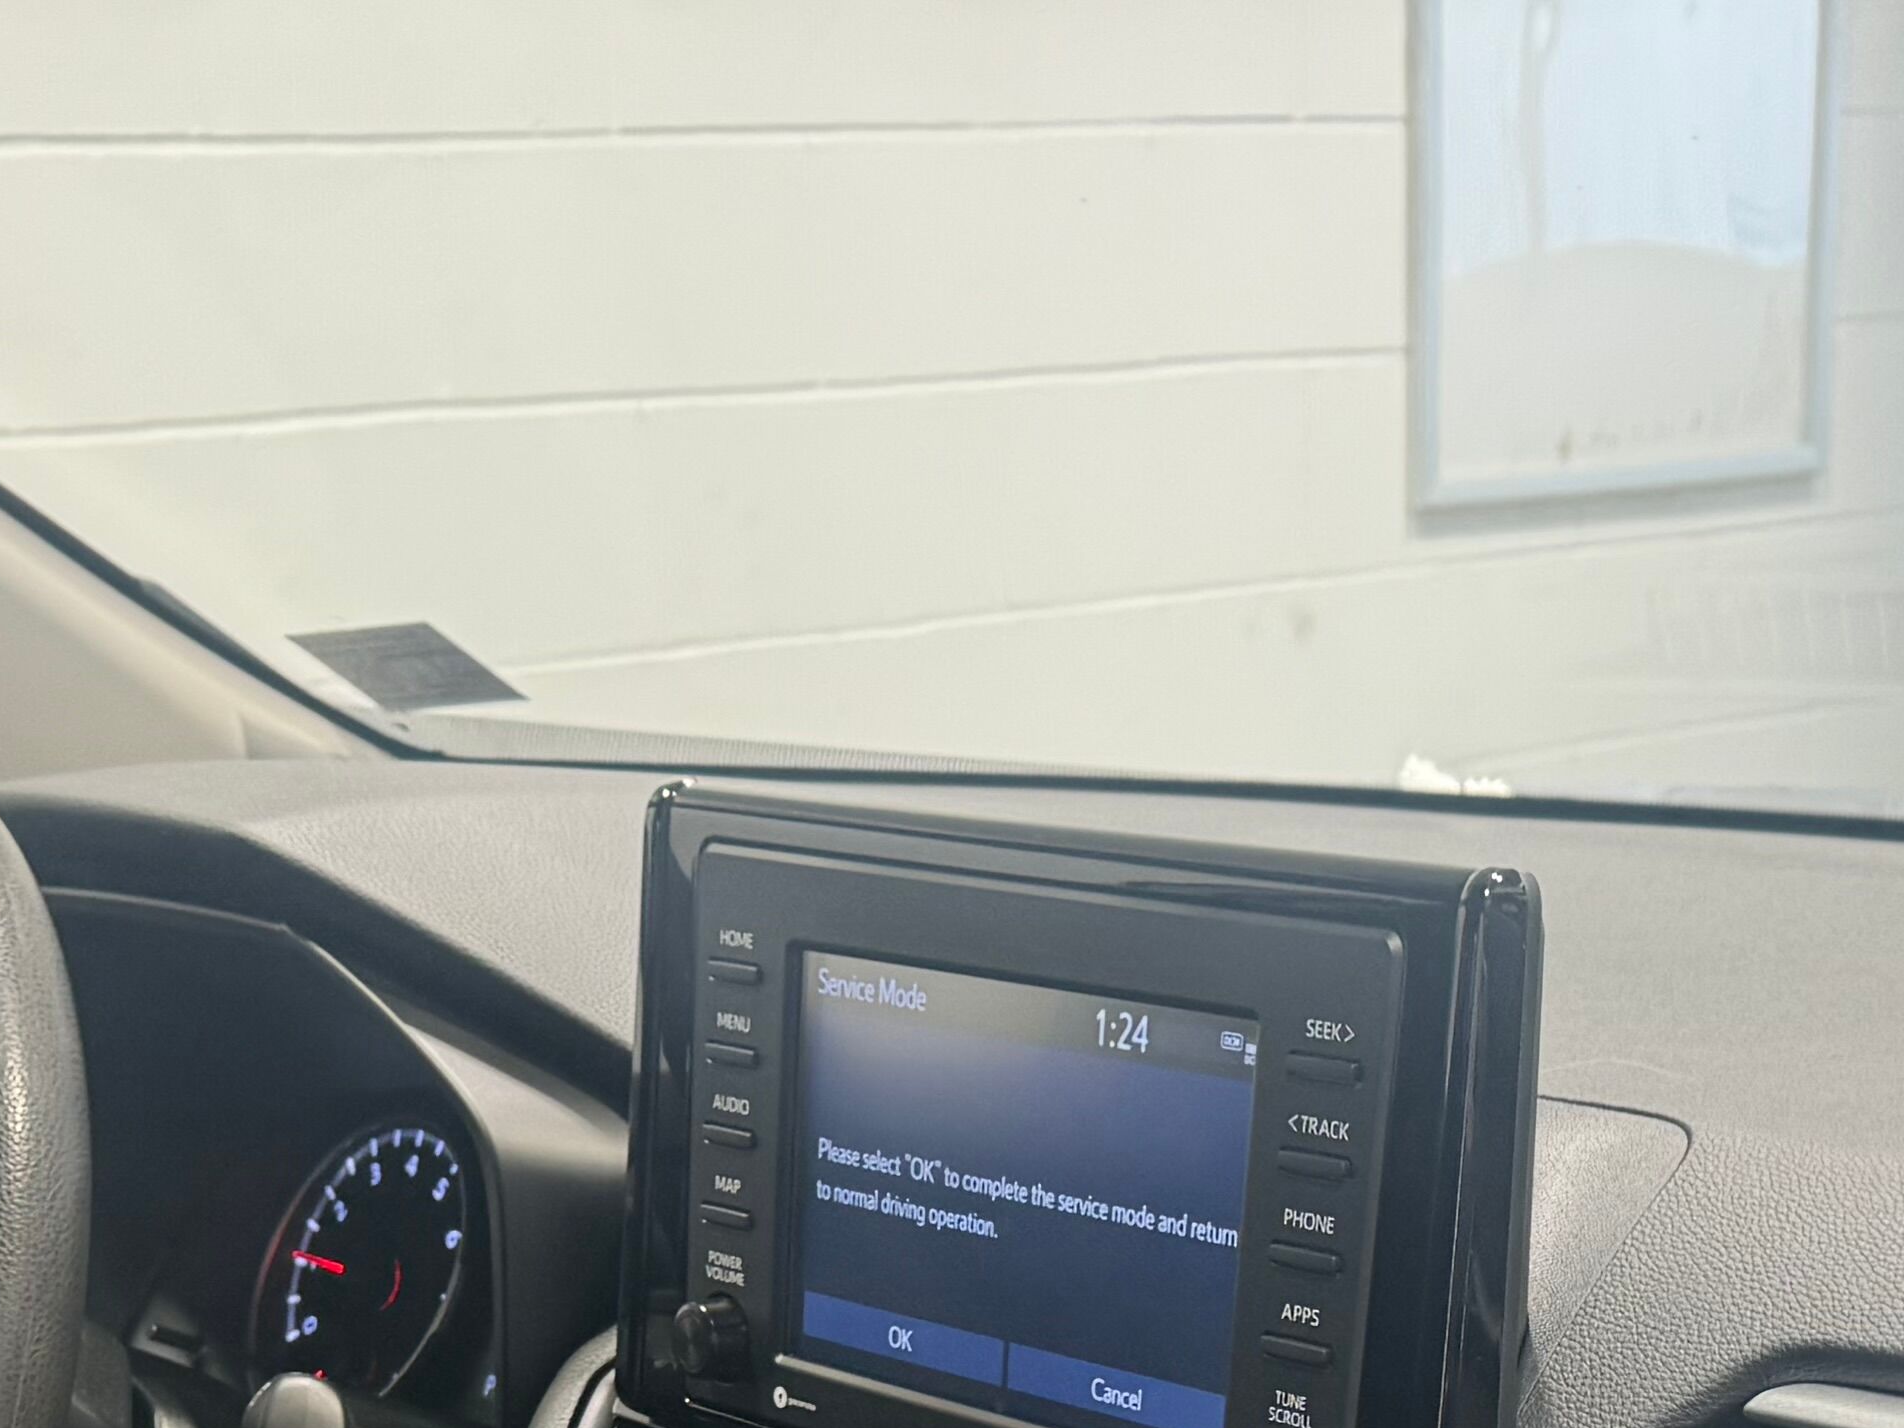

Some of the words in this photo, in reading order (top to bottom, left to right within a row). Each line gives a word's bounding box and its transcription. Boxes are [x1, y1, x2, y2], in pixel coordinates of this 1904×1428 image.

[719, 929, 753, 949] HOME
[818, 967, 875, 1003] Service
[879, 977, 927, 1011] Mode
[716, 1012, 751, 1033] MENU
[1096, 1009, 1149, 1053] 1:24
[712, 1094, 750, 1115] AUDIO
[714, 1175, 742, 1194] MAP
[818, 1137, 860, 1167] Please
[862, 1149, 901, 1176] select
[905, 1154, 942, 1184] "OK"
[944, 1167, 960, 1188] to
[962, 1173, 1028, 1204] complete
[1032, 1182, 1055, 1209] the
[1058, 1191, 1109, 1222] service
[1111, 1204, 1155, 1230] mode
[1157, 1213, 1188, 1238] and
[1191, 1220, 1239, 1249] return
[816, 1180, 831, 1201] to
[833, 1188, 878, 1212] normal
[881, 1192, 926, 1226] driving
[928, 1207, 999, 1239] operation.
[1283, 1207, 1336, 1235] PHONE
[708, 1250, 742, 1270] POWER
[705, 1264, 745, 1287] VOLUME
[301, 1315, 318, 1336] 0
[1281, 1302, 1320, 1327] APPS
[888, 1325, 913, 1352] OK
[1091, 1377, 1143, 1411] Cancel
[1275, 1389, 1307, 1411] TUNE
